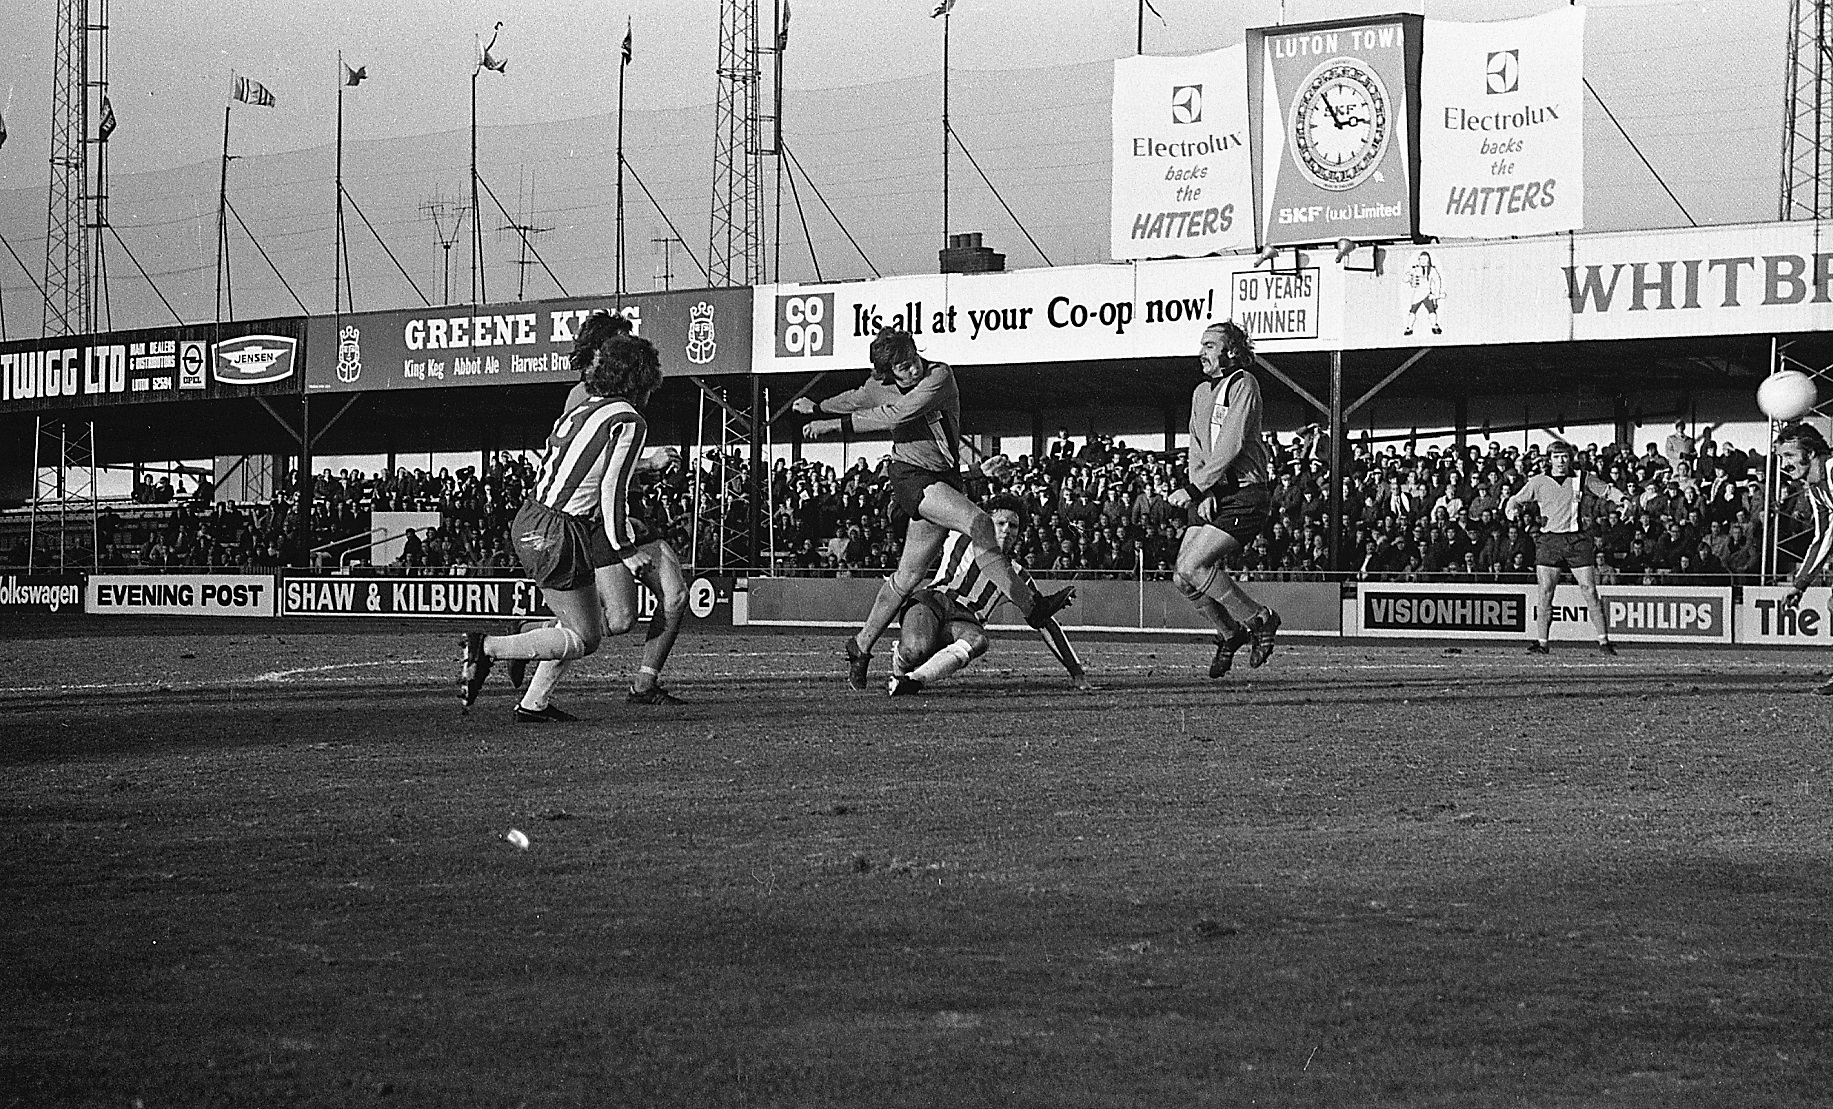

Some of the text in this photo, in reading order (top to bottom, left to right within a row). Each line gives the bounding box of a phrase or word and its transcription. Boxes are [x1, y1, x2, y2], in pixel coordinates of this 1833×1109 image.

[1275, 33, 1339, 58] LUTON
[1323, 104, 1358, 118] SKF
[1444, 103, 1560, 132] Electrolux
[1133, 132, 1242, 158] Electrolux
[1480, 137, 1525, 155] backs
[1165, 164, 1209, 182] backs
[1491, 158, 1516, 176] the
[1175, 184, 1202, 203] the
[1445, 177, 1557, 216] HATTERS
[1131, 202, 1235, 241] HATTERS
[1278, 206, 1323, 225] SKF
[1353, 200, 1402, 220] Limited
[1239, 274, 1313, 302] 90 YEARS
[853, 288, 1215, 341] It's all at your Co-op now!
[1242, 309, 1307, 335] WINNER
[404, 313, 537, 351] GREENE
[234, 352, 274, 364] JENSEN
[404, 359, 425, 381] King
[427, 358, 445, 380] Keg
[453, 356, 482, 376] Abbot
[484, 355, 500, 374] Ale
[511, 353, 549, 373] Harvest
[0, 344, 126, 401] TWIGG LTD
[183, 376, 202, 384] OPEL
[97, 584, 264, 607] EVENING POST
[287, 582, 355, 611] SHAW
[366, 583, 381, 611] &
[392, 583, 500, 613] KILBURN
[699, 588, 710, 608] 2
[1370, 598, 1518, 626] VISIONHIRE
[1609, 601, 1713, 630] PHILIPS
[1754, 599, 1821, 637] The
